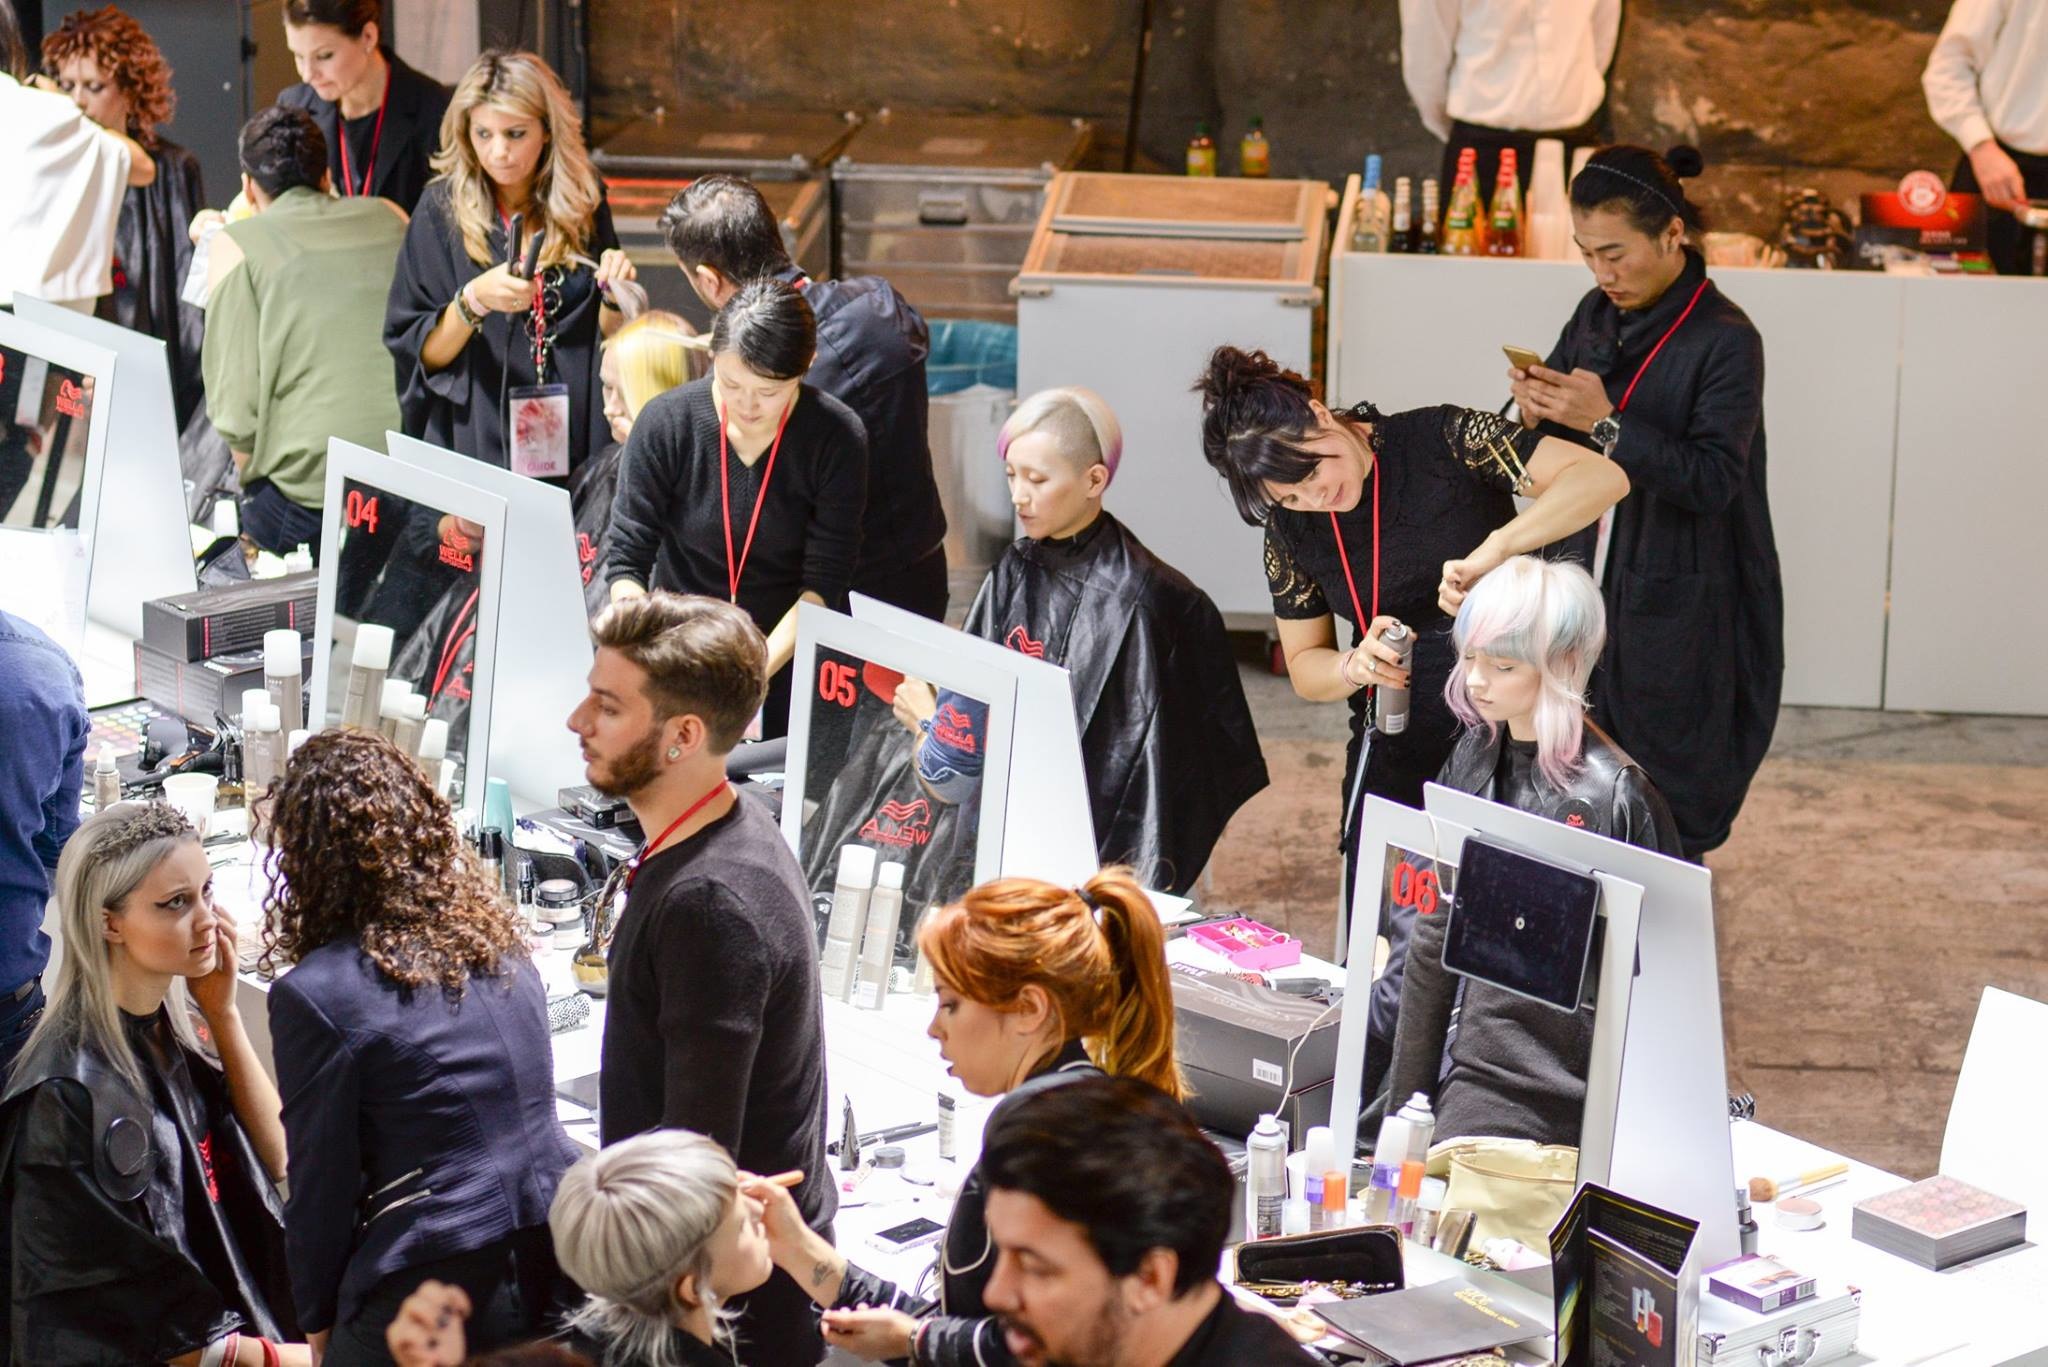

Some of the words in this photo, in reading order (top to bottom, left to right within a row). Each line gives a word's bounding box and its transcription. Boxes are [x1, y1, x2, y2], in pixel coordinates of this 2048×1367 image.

[346, 490, 380, 534] 04
[438, 544, 473, 567] WELLA
[819, 660, 857, 708] 05
[934, 724, 977, 748] WELLA
[1392, 861, 1438, 915] 06
